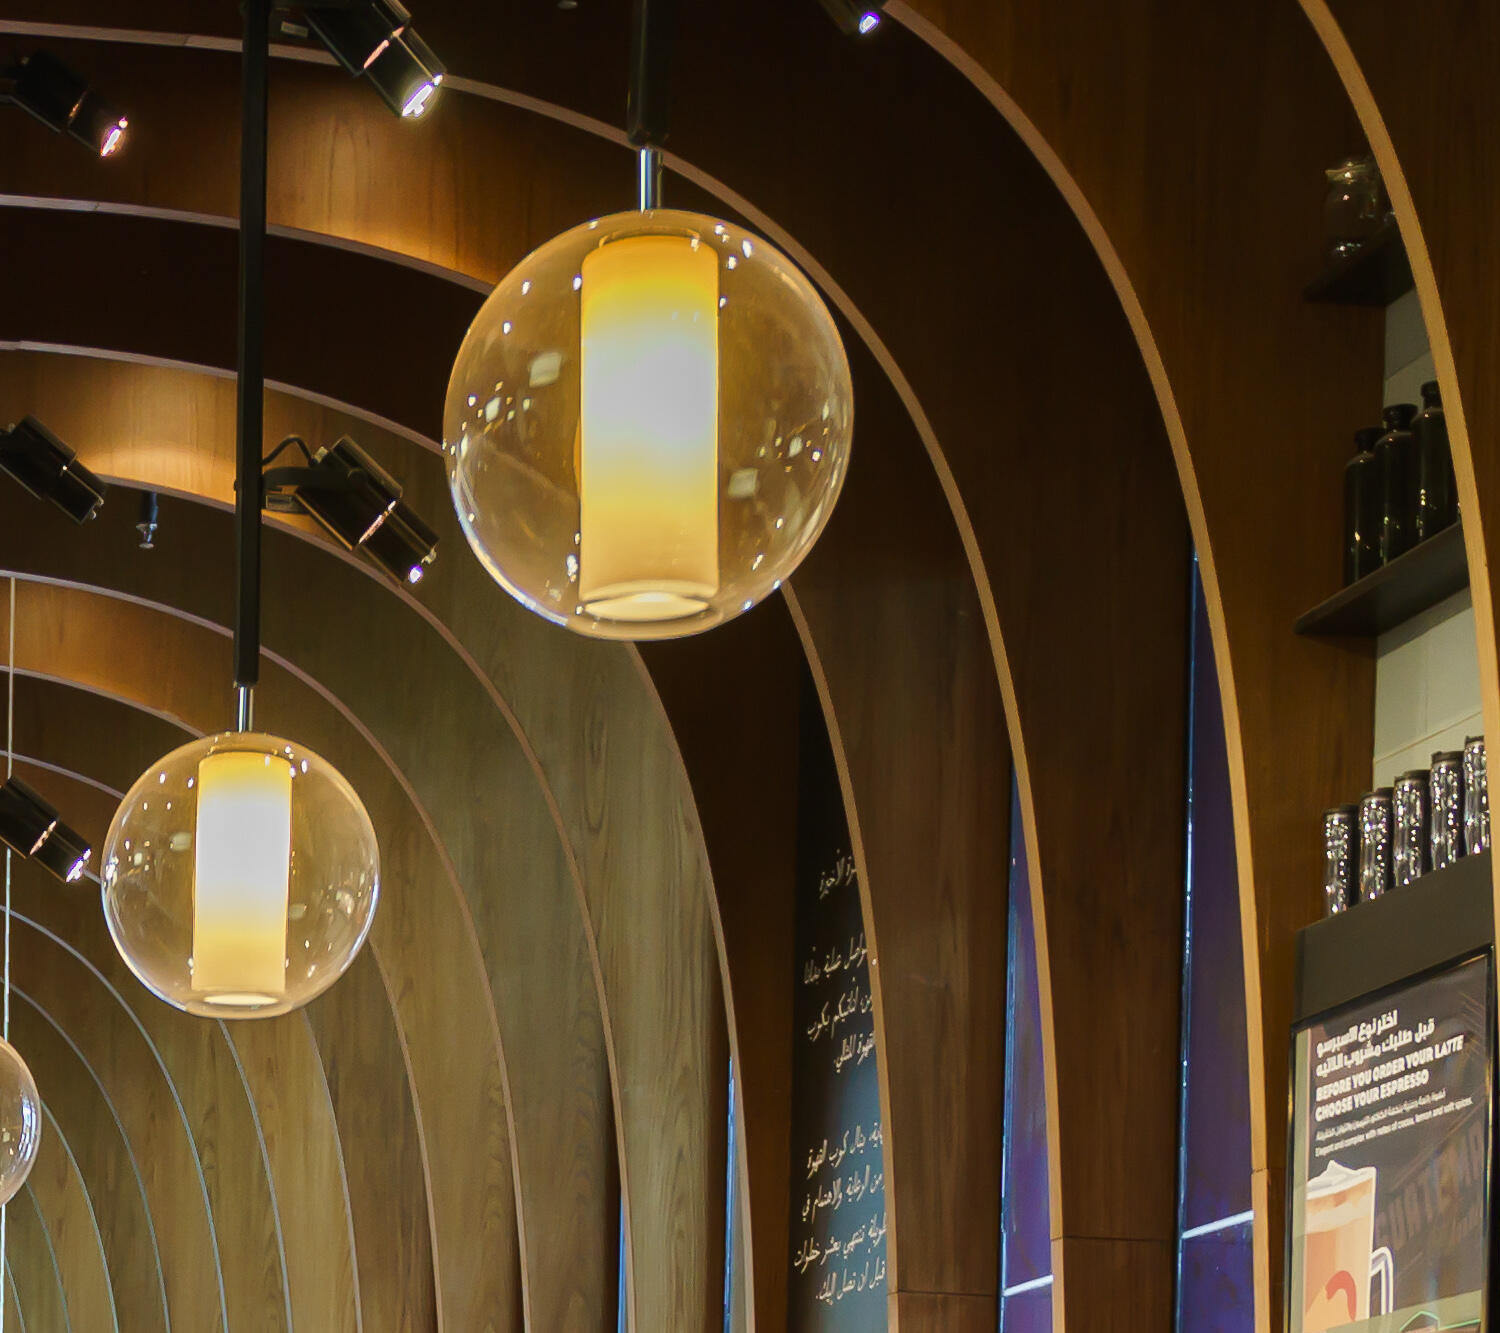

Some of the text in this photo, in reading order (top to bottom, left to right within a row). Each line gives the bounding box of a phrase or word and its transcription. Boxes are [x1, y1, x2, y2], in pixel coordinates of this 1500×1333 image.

[1315, 1096, 1353, 1122] CHOOSE
[1353, 1086, 1380, 1108] YOUR
[1380, 1068, 1430, 1099] ESPRESSO
[1316, 1034, 1465, 1101] BEFORE YOU ORDER YOUR LATTE
